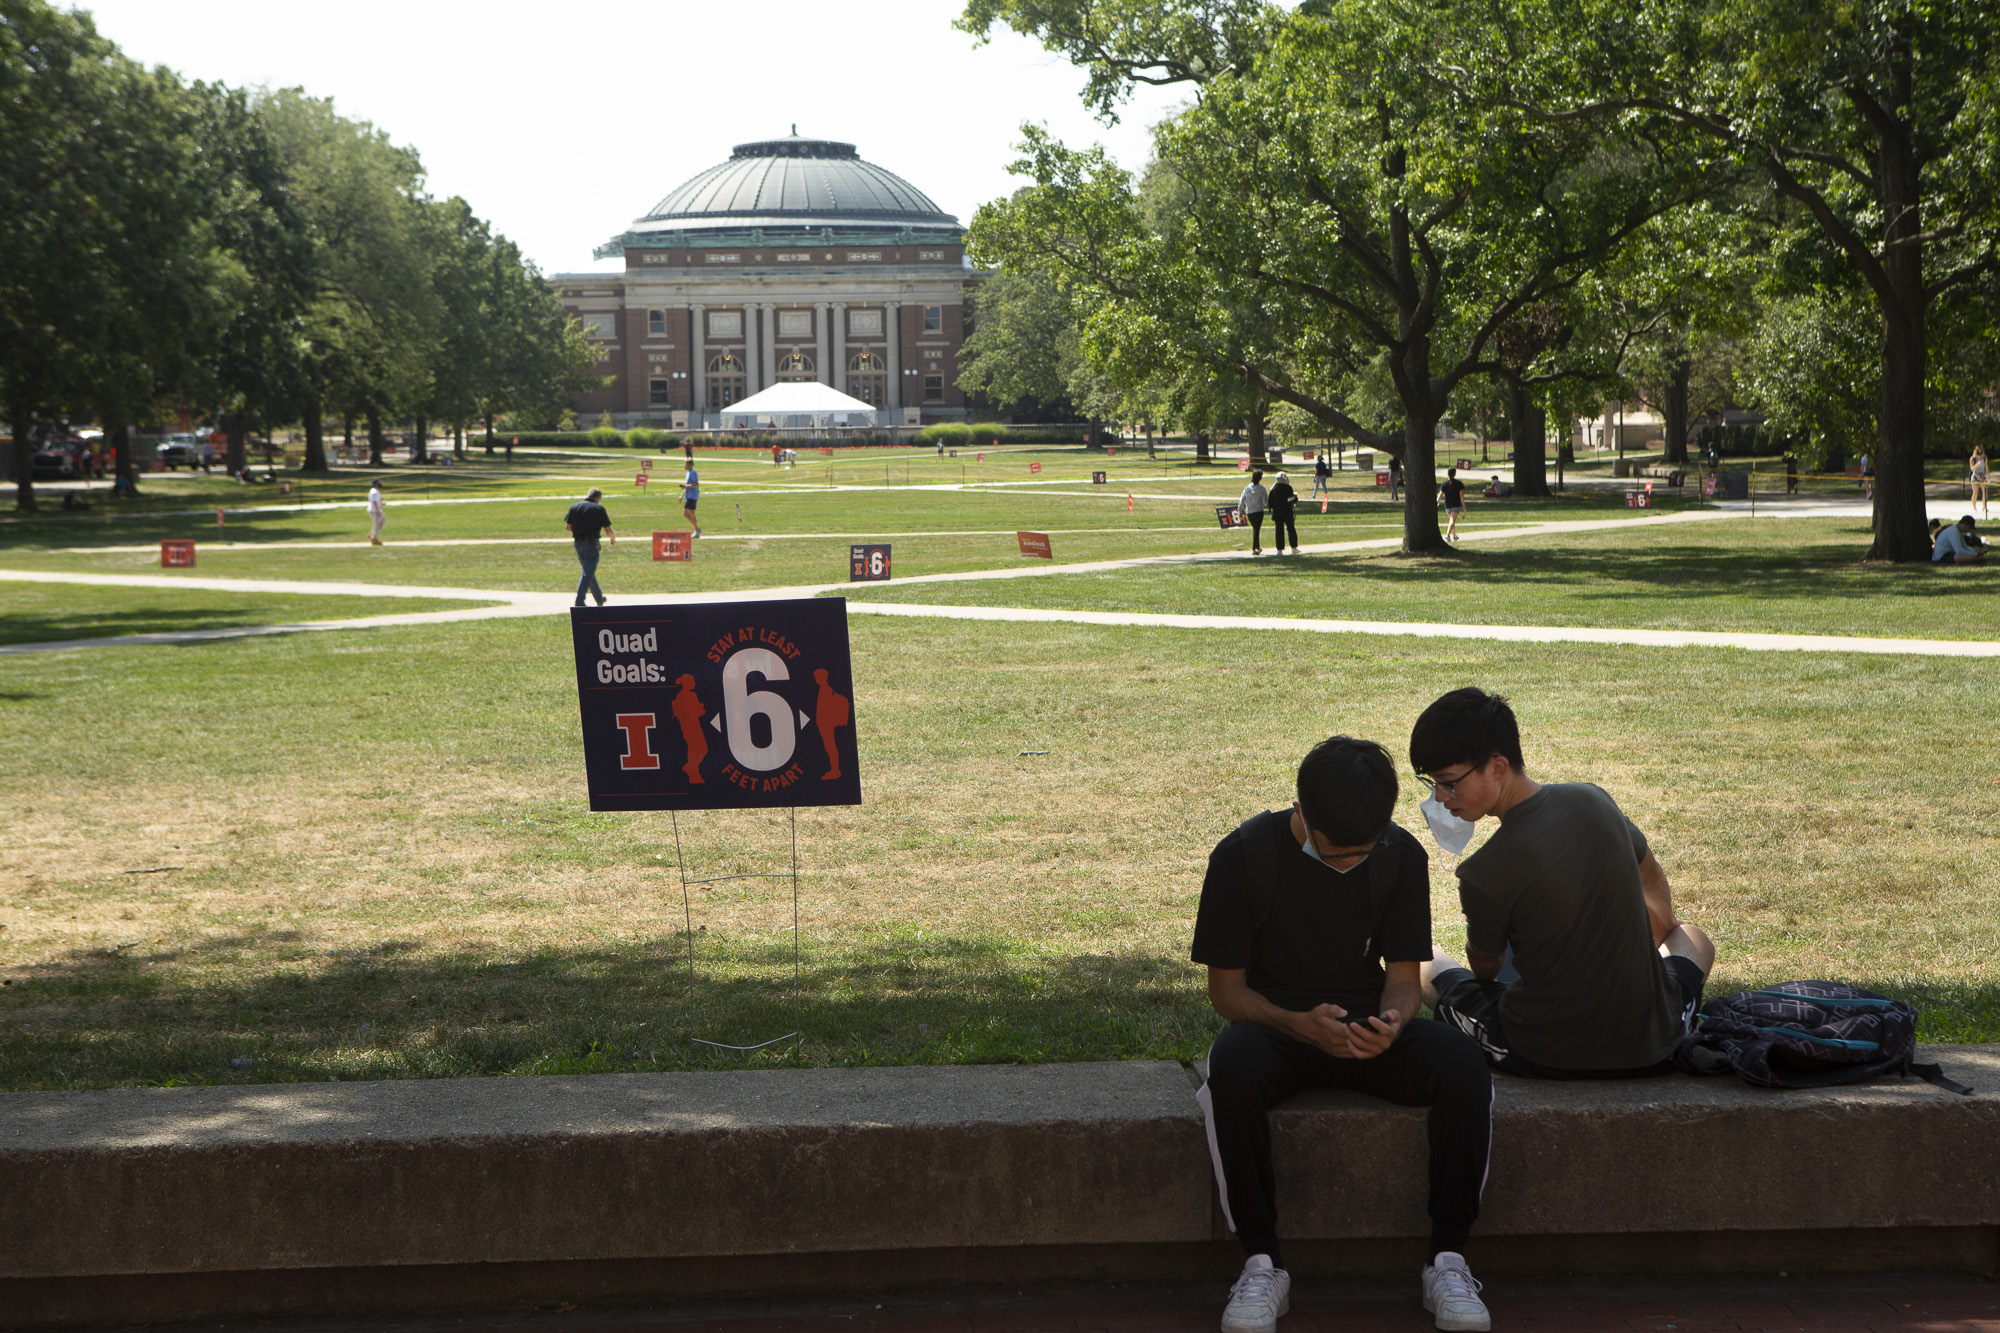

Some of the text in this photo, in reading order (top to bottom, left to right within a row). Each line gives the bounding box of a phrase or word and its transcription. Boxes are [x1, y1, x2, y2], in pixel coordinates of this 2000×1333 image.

[1638, 494, 1645, 507] 6
[1232, 510, 1240, 524] 6
[855, 563, 862, 575] I
[871, 551, 883, 575] 6
[598, 627, 658, 655] Quad
[706, 627, 801, 663] STAY AT LEAST
[597, 658, 666, 684] Goals:
[722, 647, 796, 771] 6
[615, 712, 660, 770] I
[721, 762, 804, 793] FEET APART
